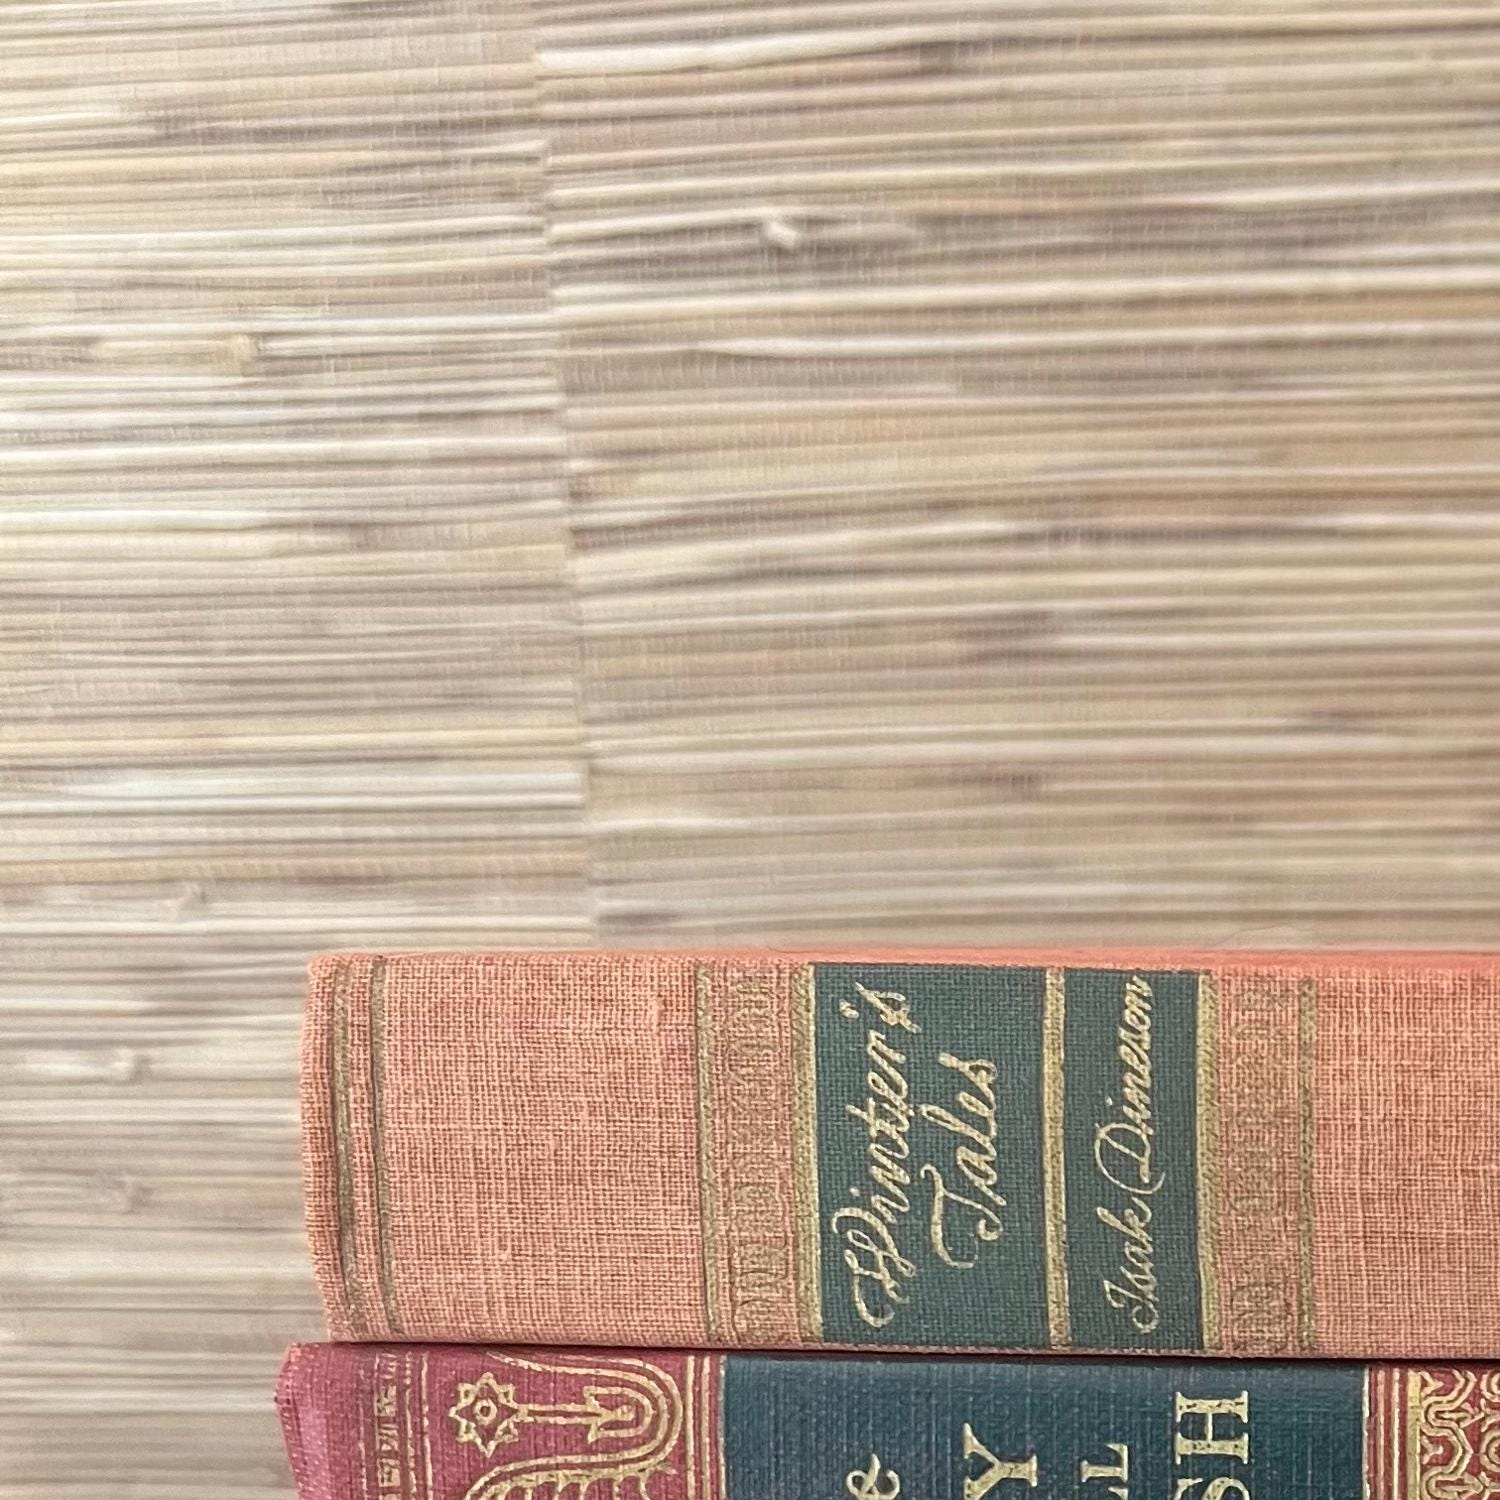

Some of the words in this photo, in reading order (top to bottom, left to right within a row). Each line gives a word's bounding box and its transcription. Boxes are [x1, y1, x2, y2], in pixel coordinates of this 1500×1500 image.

[831, 983, 922, 1328] Winter's
[920, 1052, 1007, 1269] Tales
[1094, 976, 1166, 1195] Dinesen
[1097, 1206, 1160, 1334] Isak
